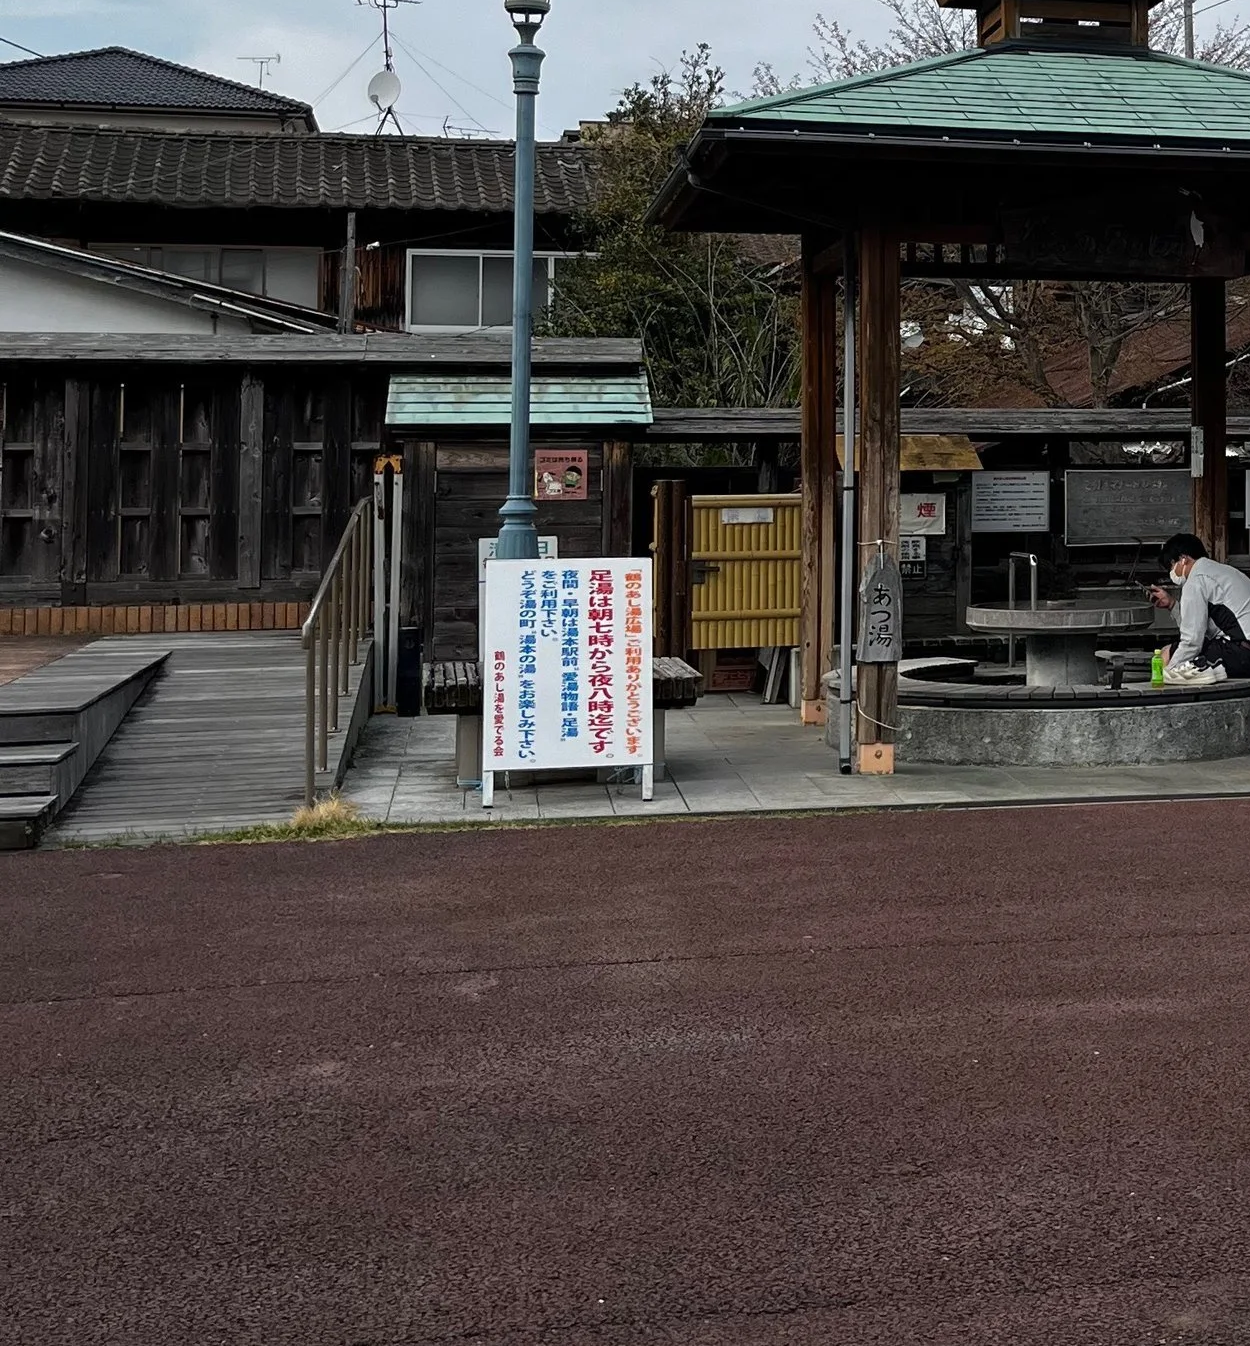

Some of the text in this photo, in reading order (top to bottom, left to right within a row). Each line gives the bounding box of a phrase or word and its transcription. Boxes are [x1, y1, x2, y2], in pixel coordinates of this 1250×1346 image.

[540, 570, 558, 641] をご利用下さい。
[868, 585, 893, 648] あつ湯
[588, 569, 614, 758] 足湯は朝七時から夜八時迄です。
